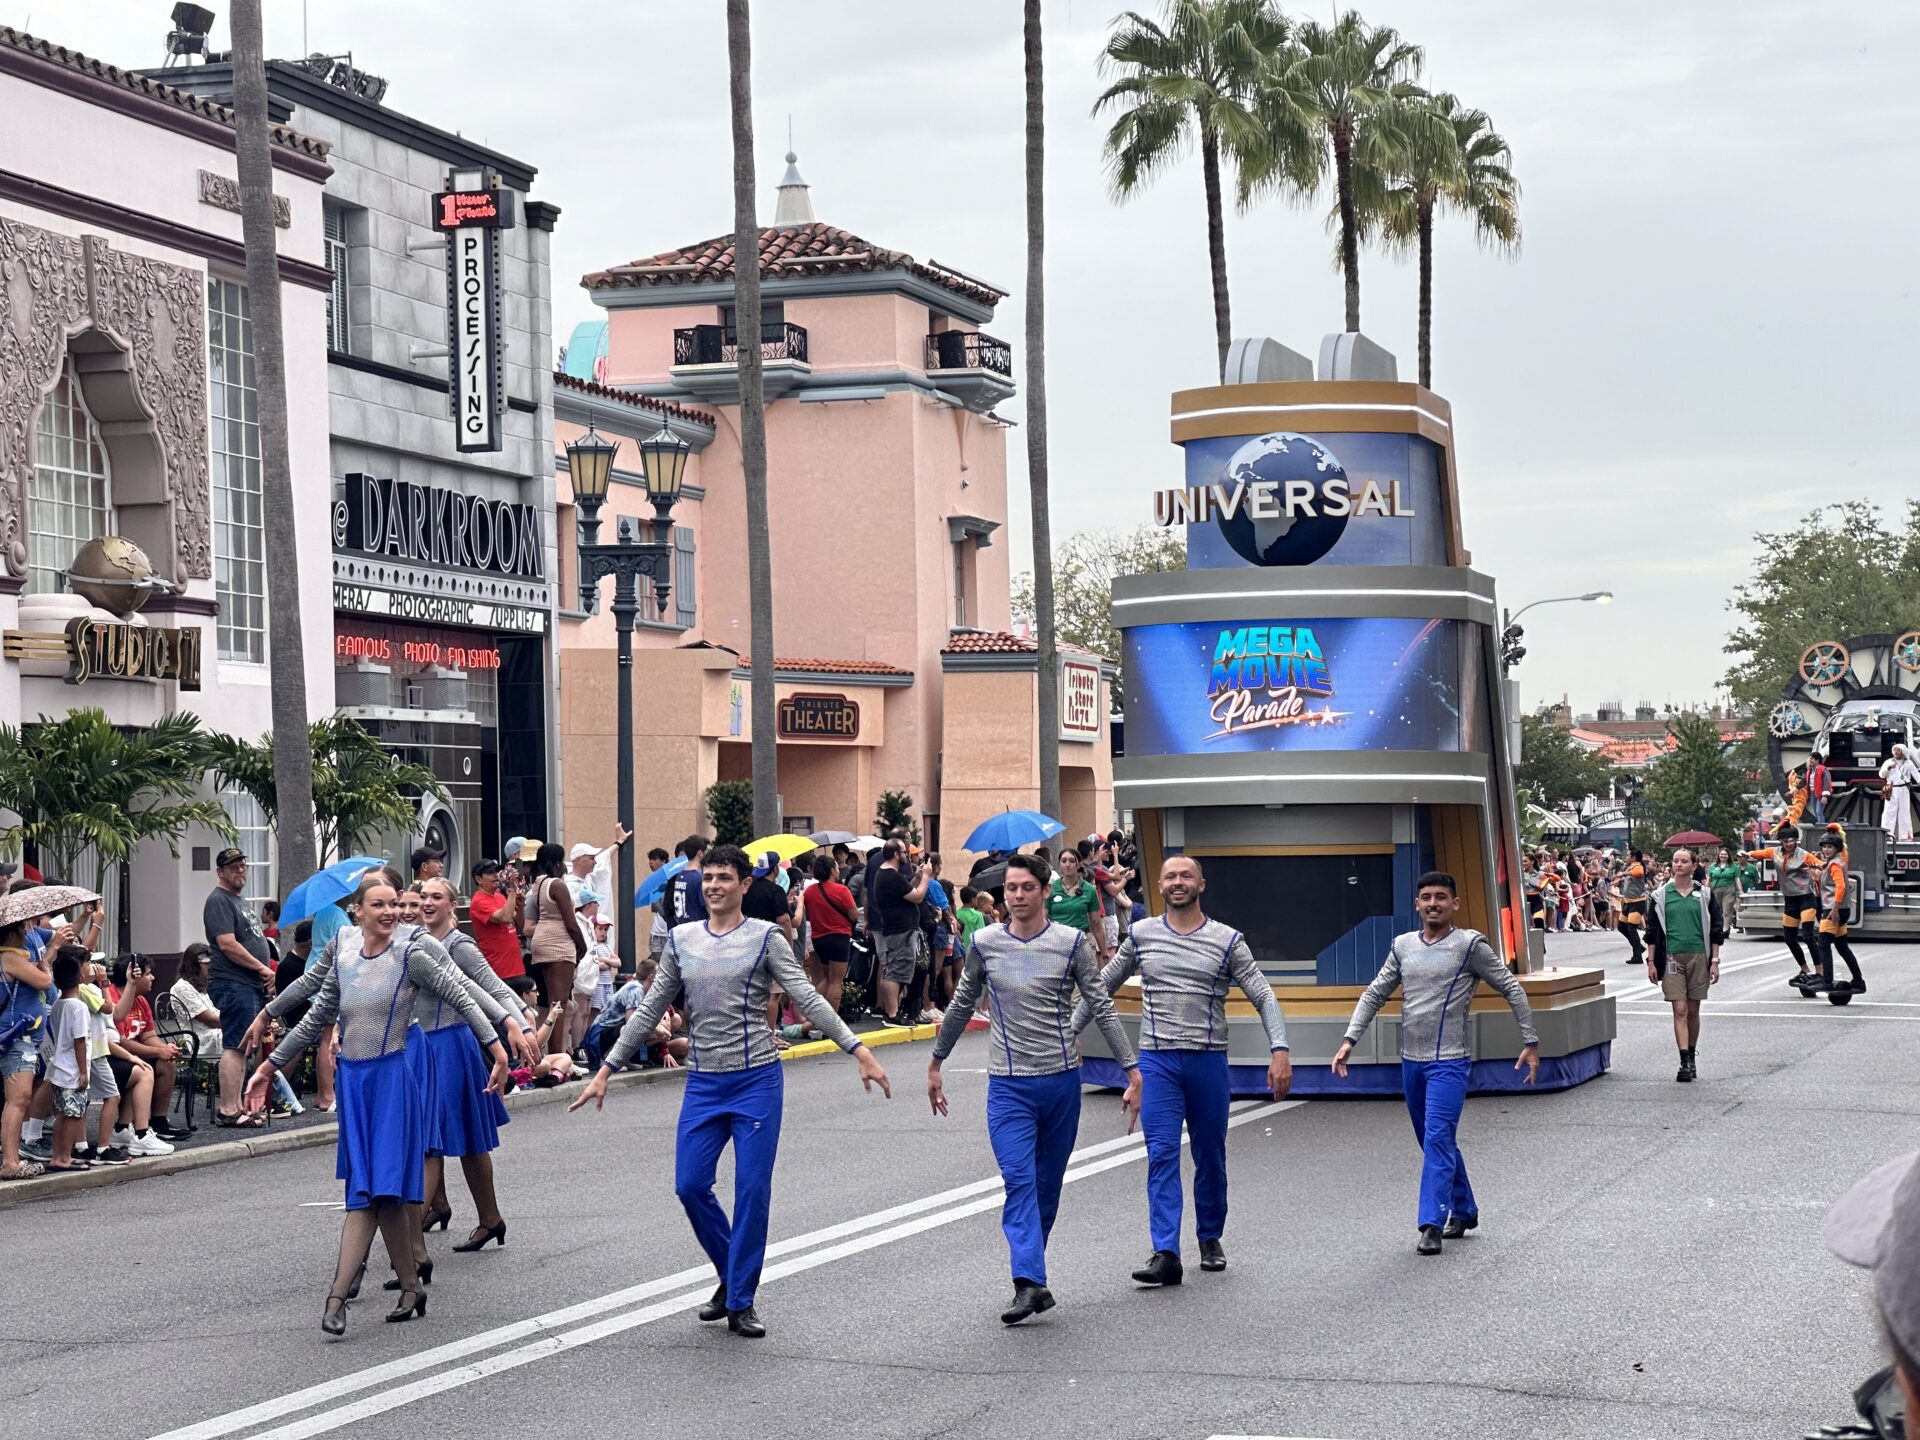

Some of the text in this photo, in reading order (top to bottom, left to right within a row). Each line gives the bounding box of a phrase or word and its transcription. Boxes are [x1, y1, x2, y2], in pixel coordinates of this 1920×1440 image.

[440, 194, 461, 226] 1
[464, 237, 484, 434] PROCESSING
[1153, 479, 1416, 527] UNIVERSAL
[361, 472, 545, 579] DARKROOM
[389, 593, 475, 625] PHOTOGRAPHIC
[489, 605, 537, 631] SUPPLIES
[74, 615, 168, 686] STUDIO
[336, 634, 501, 669] FAMOUS PHOTO FINISHING
[1212, 626, 1326, 664] MEGA
[1205, 655, 1336, 699] MOVIE
[782, 706, 855, 734] THEATER
[801, 700, 840, 709] TRIBUTE
[1209, 685, 1304, 734] Parade
